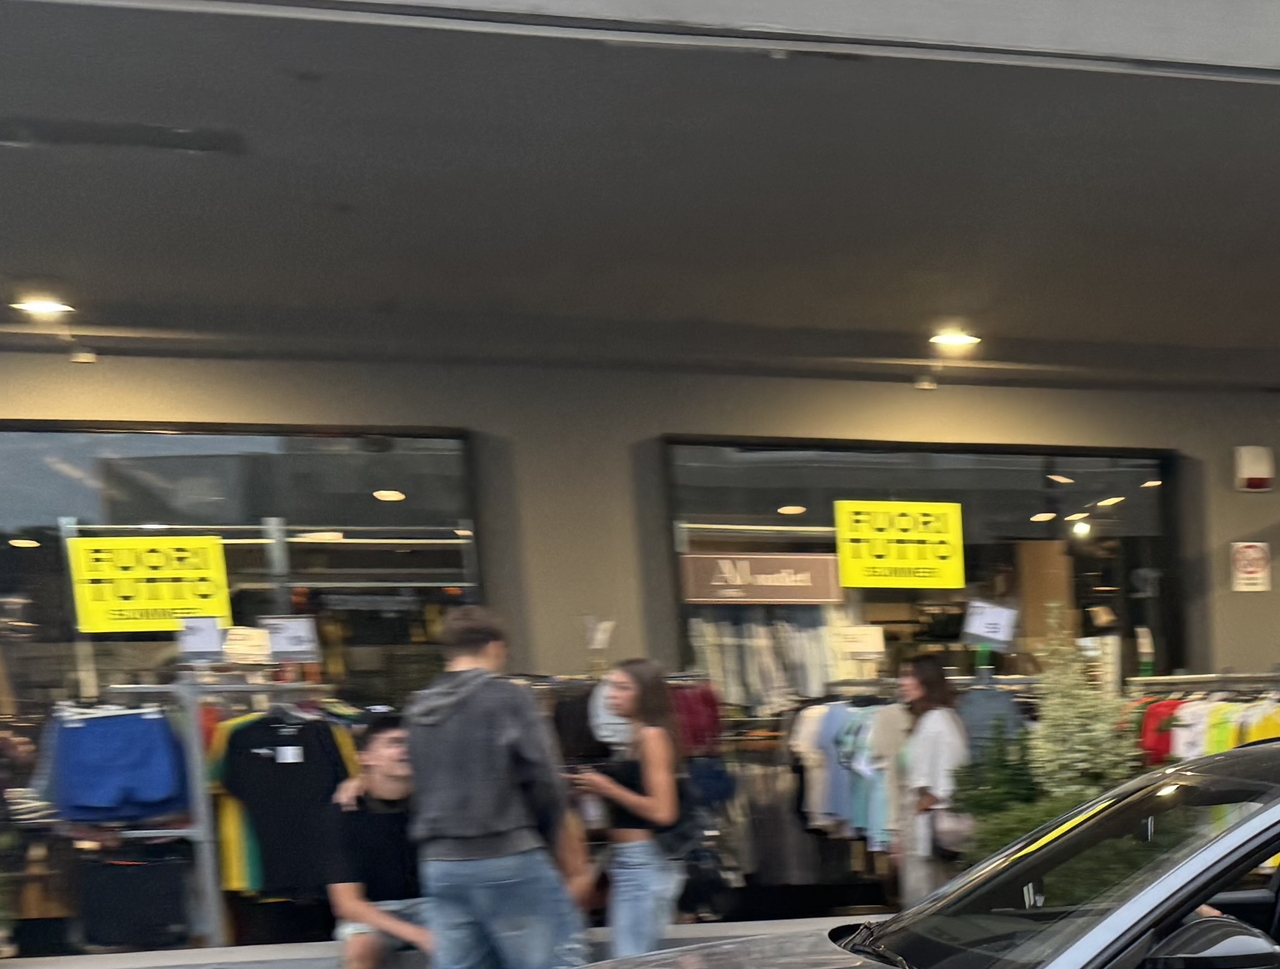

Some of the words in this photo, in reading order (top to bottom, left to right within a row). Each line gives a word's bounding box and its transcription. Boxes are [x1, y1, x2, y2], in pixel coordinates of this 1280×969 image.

[850, 511, 949, 533] FUORI
[85, 547, 212, 571] FUORI
[844, 538, 954, 560] TUTTO
[79, 577, 217, 601] TUTTO
